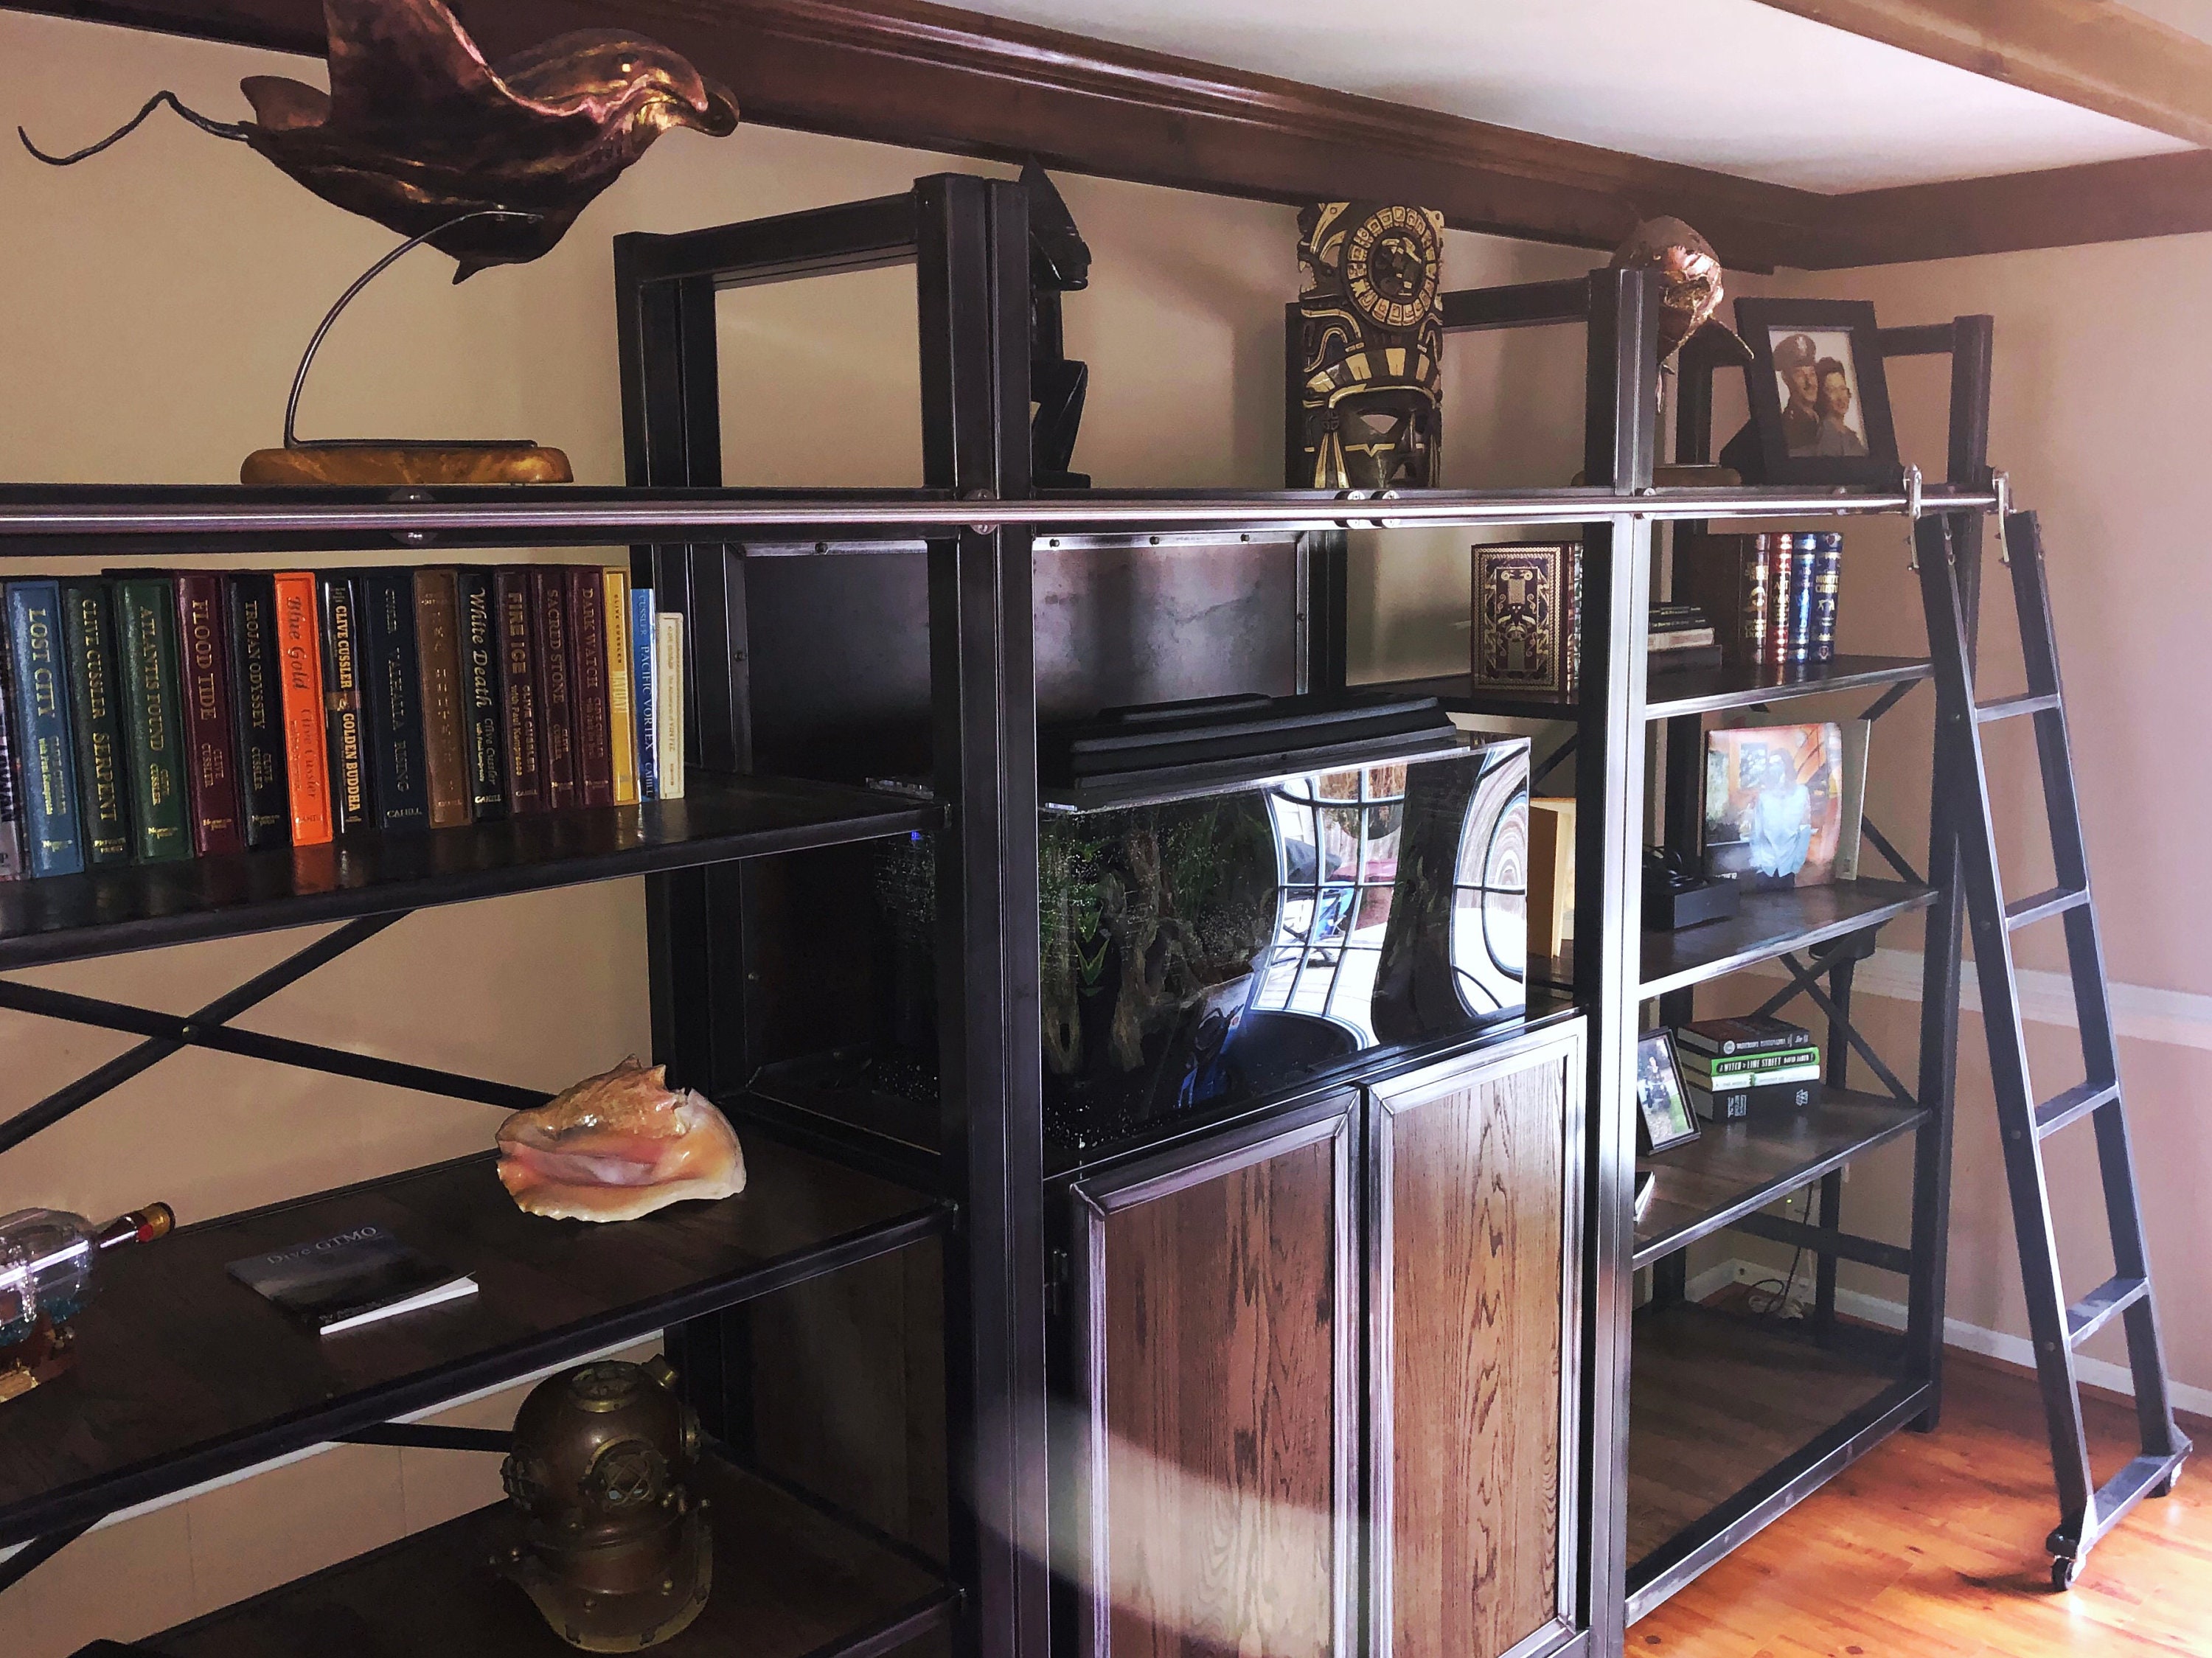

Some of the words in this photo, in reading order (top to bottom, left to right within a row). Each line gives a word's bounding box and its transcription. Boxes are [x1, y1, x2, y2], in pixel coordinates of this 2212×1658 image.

[82, 599, 100, 645] CLIVE
[244, 599, 261, 661] TROJAN
[286, 596, 307, 641] Blue
[335, 605, 349, 639] CLIVE
[469, 587, 489, 644] White
[507, 592, 524, 636] FIRE
[547, 589, 562, 650] SACRED
[582, 588, 597, 631] DARK
[638, 594, 648, 637] CUSSLER
[29, 608, 50, 663] LOST
[140, 605, 160, 691] ATLANTIS
[192, 599, 213, 670] FLOOD
[510, 641, 526, 674] ICE
[87, 650, 106, 719] CUSSLER
[287, 646, 311, 690] Gold
[335, 640, 353, 689] CUSSLER
[473, 649, 493, 708] Death
[550, 653, 565, 704] STONE
[585, 633, 599, 689] WATCH
[640, 645, 653, 696] PACIFIC
[34, 668, 56, 718] CITY
[197, 672, 218, 721] TIDE
[248, 662, 266, 730] ODYSSEY
[509, 684, 521, 706] with
[512, 707, 521, 726] Paul
[521, 684, 533, 718] CLIVE
[147, 693, 165, 753] FOUND
[343, 712, 358, 760] GOLDEN
[484, 717, 495, 745] Clive
[524, 721, 536, 773] CUSSLER
[643, 697, 655, 752] VORTEX
[93, 732, 118, 822] SERPENT
[346, 762, 361, 812] BUDDHA
[485, 747, 498, 786] Cussler
[1761, 1056, 1781, 1067] STREET
[316, 1225, 378, 1251] GTMO
